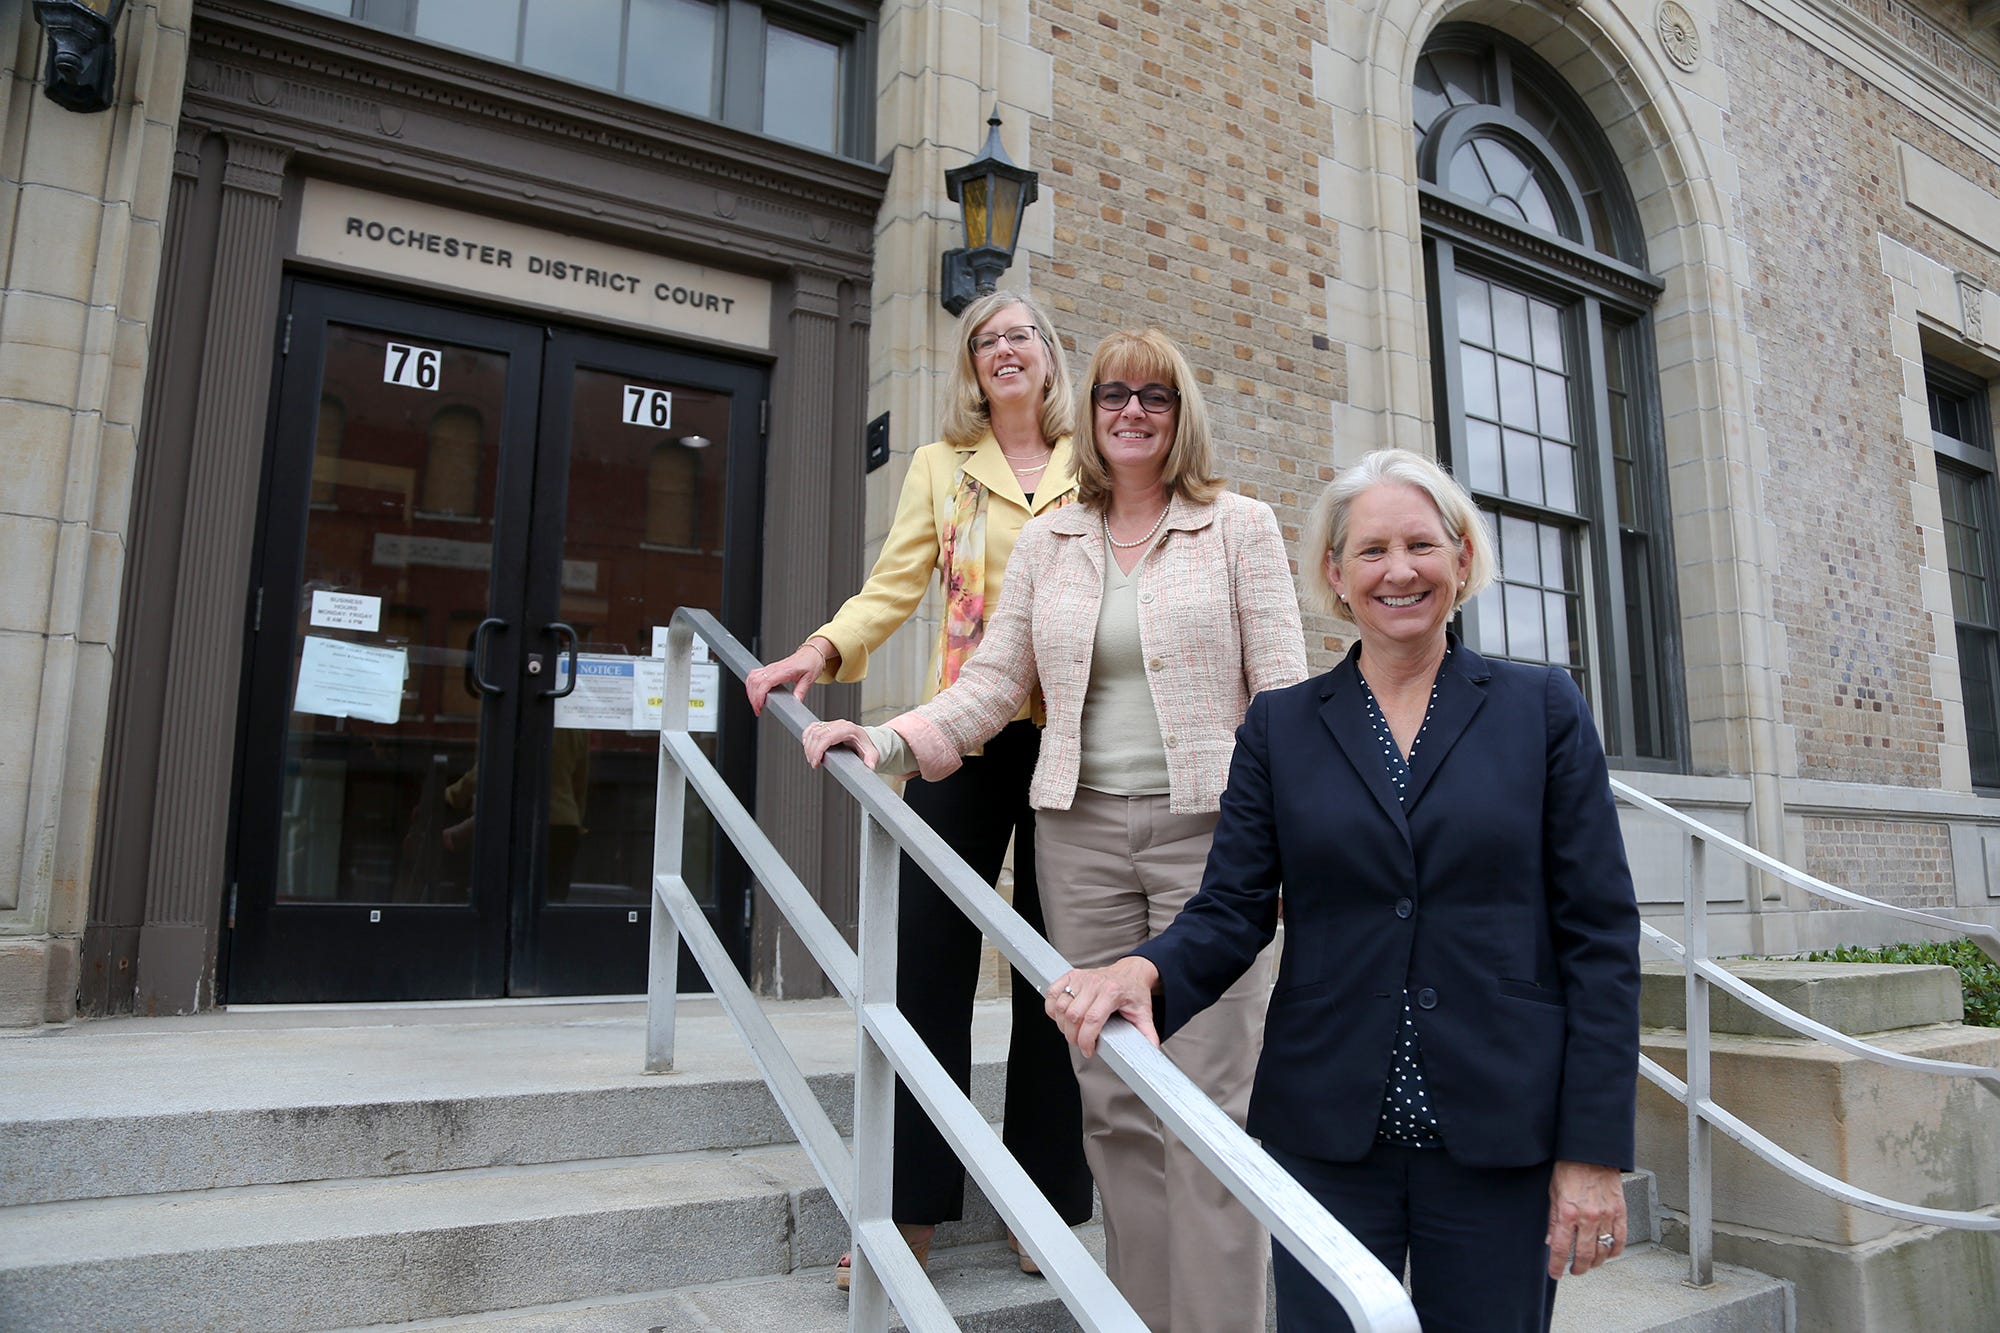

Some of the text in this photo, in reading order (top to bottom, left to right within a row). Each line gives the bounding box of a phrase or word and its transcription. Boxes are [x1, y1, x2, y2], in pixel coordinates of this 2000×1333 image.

[346, 216, 735, 314] ROCHESTER DISTRICT COURT
[391, 345, 437, 388] 76
[628, 387, 667, 427] 76
[330, 597, 363, 605] BUSINESS
[580, 664, 622, 675] NOTICE
